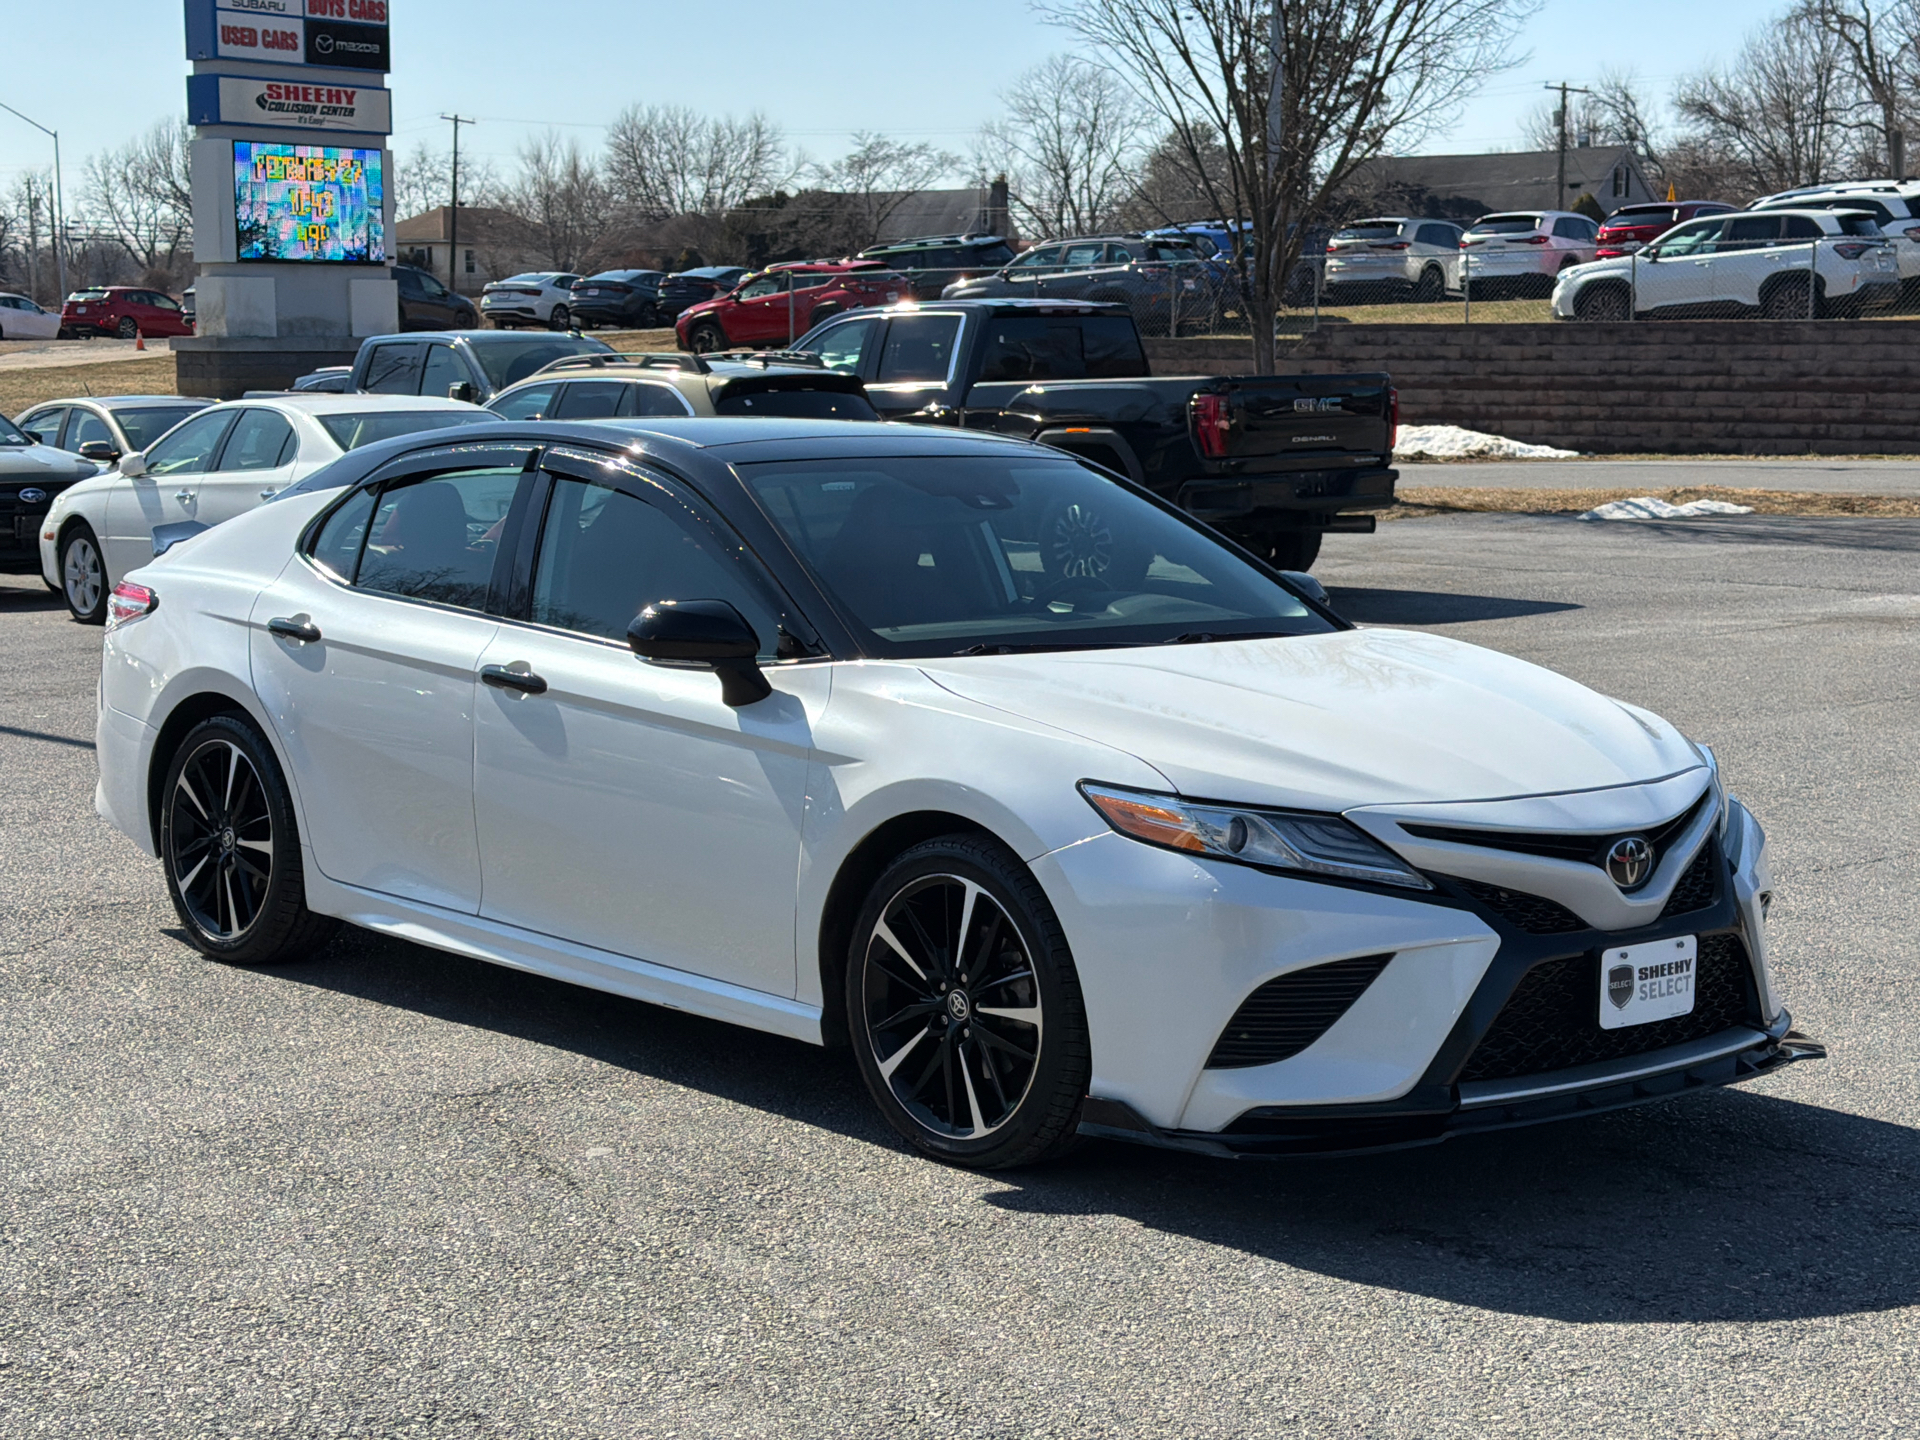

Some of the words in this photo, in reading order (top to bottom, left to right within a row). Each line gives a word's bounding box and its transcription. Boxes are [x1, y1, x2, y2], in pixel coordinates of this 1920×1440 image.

[231, 0, 286, 12] SUBARU
[307, 0, 345, 18] BUYS
[349, 0, 386, 22] CARS
[220, 24, 258, 48] USED
[261, 29, 299, 52] CARS
[266, 83, 357, 106] SHEEHY
[267, 101, 318, 115] COLLISION
[319, 105, 356, 118] CENTER
[1293, 397, 1342, 413] GMC
[1292, 435, 1337, 443] DENALI
[1638, 958, 1693, 982] SHEEHY
[1608, 979, 1634, 990] SELECT
[1638, 974, 1692, 1002] SELECT
